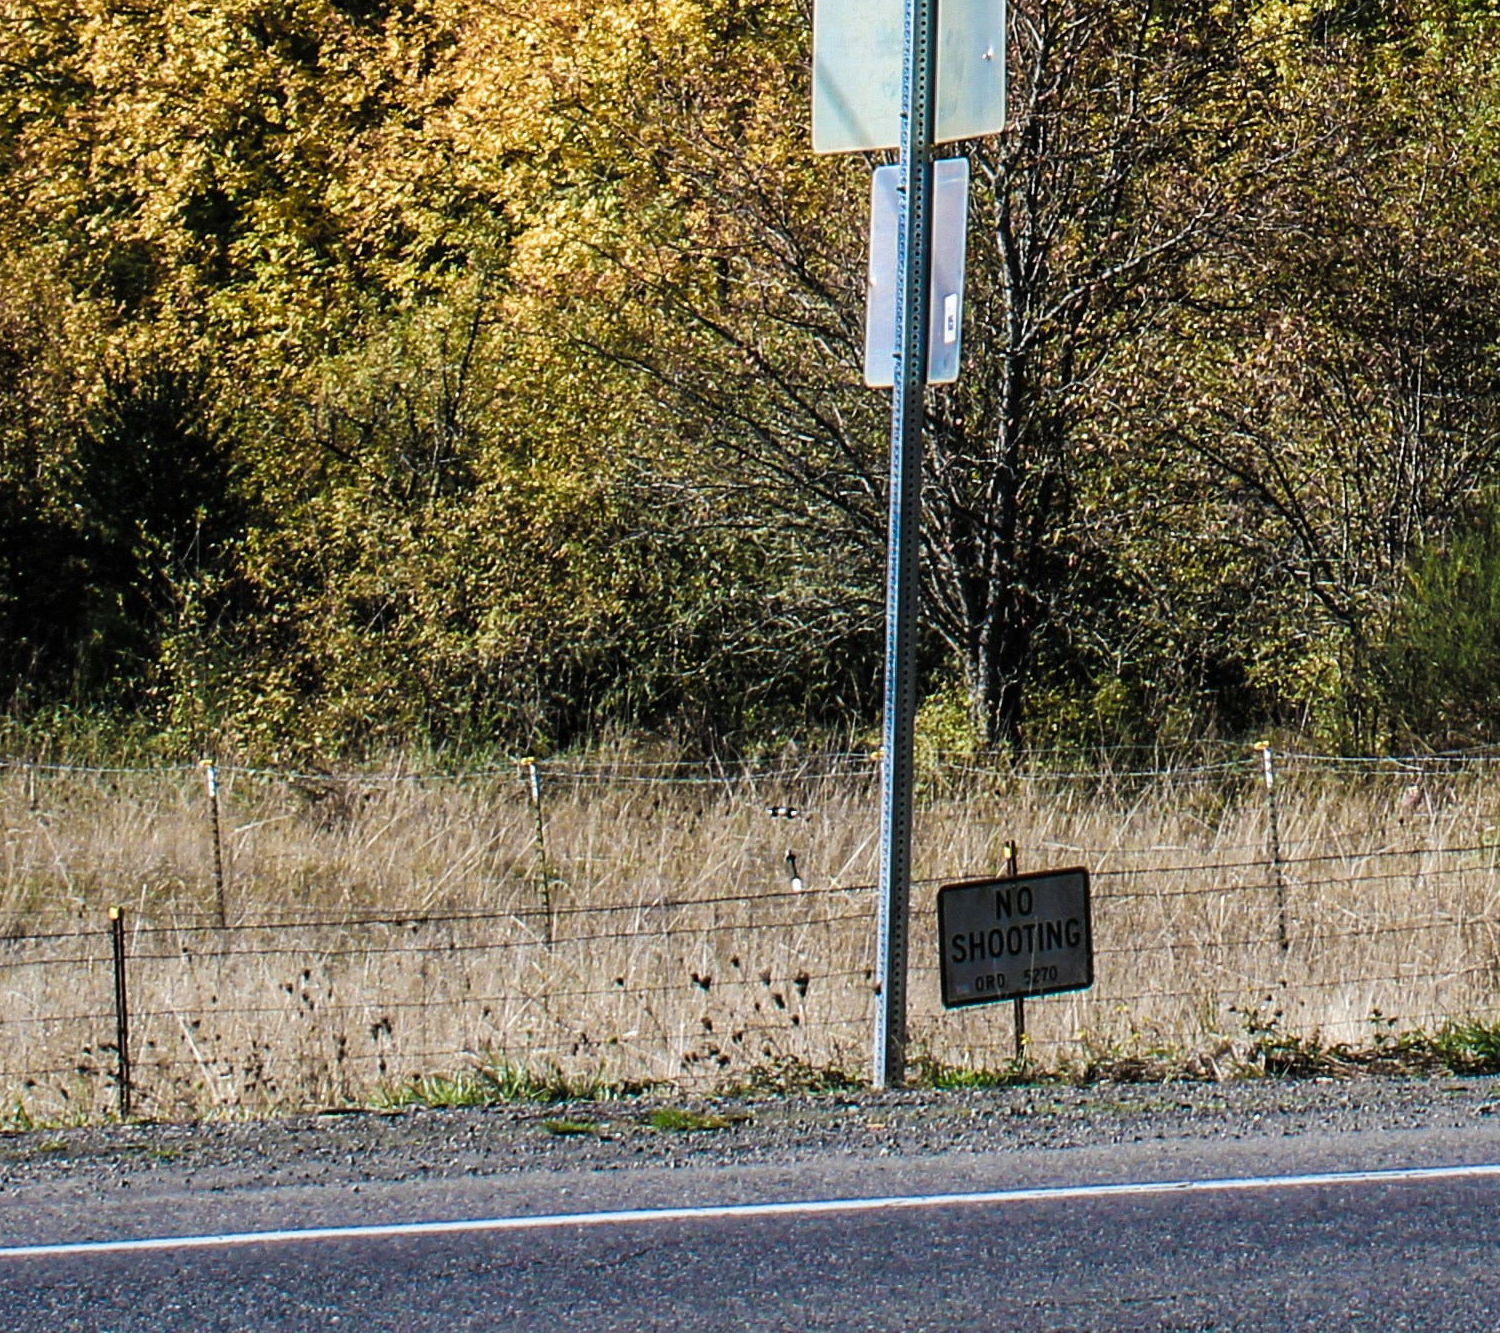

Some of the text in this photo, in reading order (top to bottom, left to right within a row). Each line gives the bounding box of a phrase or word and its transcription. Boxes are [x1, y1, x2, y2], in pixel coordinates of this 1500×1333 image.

[996, 886, 1034, 920] NO
[951, 918, 1081, 963] SHOOTING
[975, 965, 1058, 991] ORD 5270
